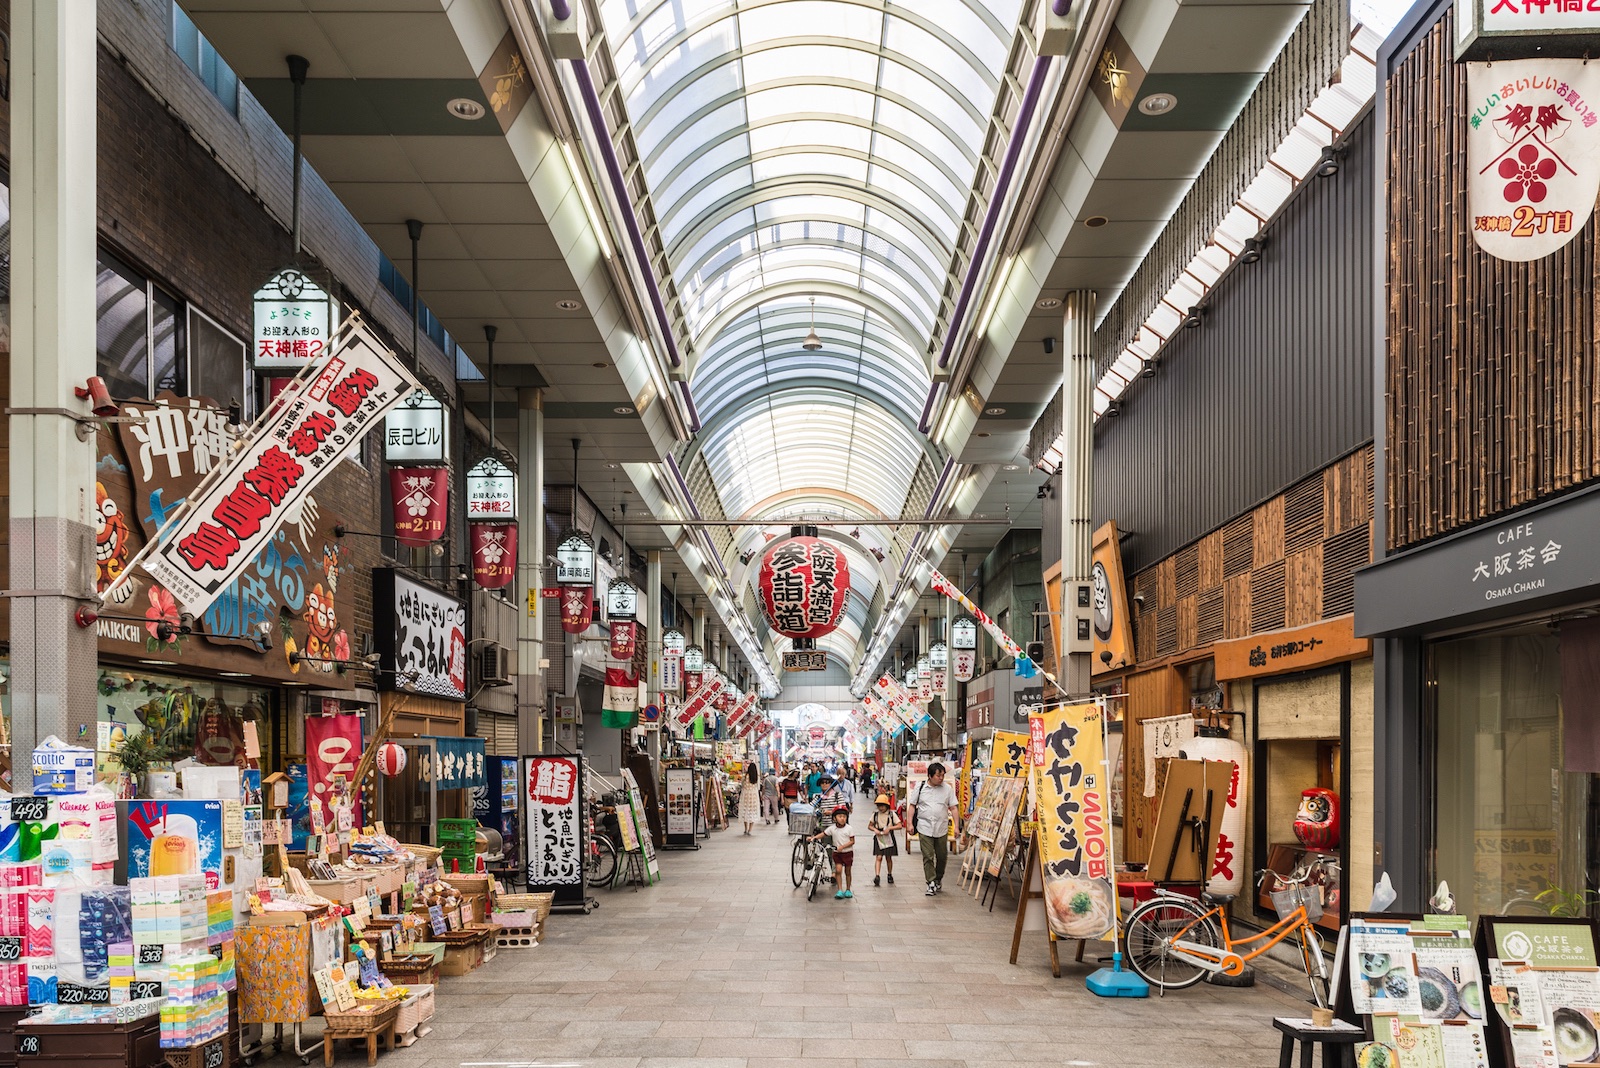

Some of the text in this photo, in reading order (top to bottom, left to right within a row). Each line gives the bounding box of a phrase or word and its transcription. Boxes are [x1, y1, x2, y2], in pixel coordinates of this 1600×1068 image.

[1475, 205, 1573, 237] 天神橋2丁目
[270, 307, 312, 320] ようこそ
[262, 326, 319, 336] お迎え人形の
[259, 340, 323, 358] 天神橋2
[470, 501, 511, 513] 天神橋2
[1497, 522, 1533, 545] CAFE
[1472, 539, 1562, 582] 大阪茶会
[772, 542, 808, 631] 参詣道
[811, 543, 835, 624] 大阪天満宮
[96, 619, 141, 643] MIKICHI
[32, 754, 65, 765] scottie
[533, 760, 573, 799] 鮨
[59, 801, 90, 812] Kleenex
[558, 806, 575, 877] 地魚にぎり
[1534, 935, 1568, 944] CAFE
[1536, 945, 1584, 954] 大阪茶会
[31, 963, 57, 972] nepia
